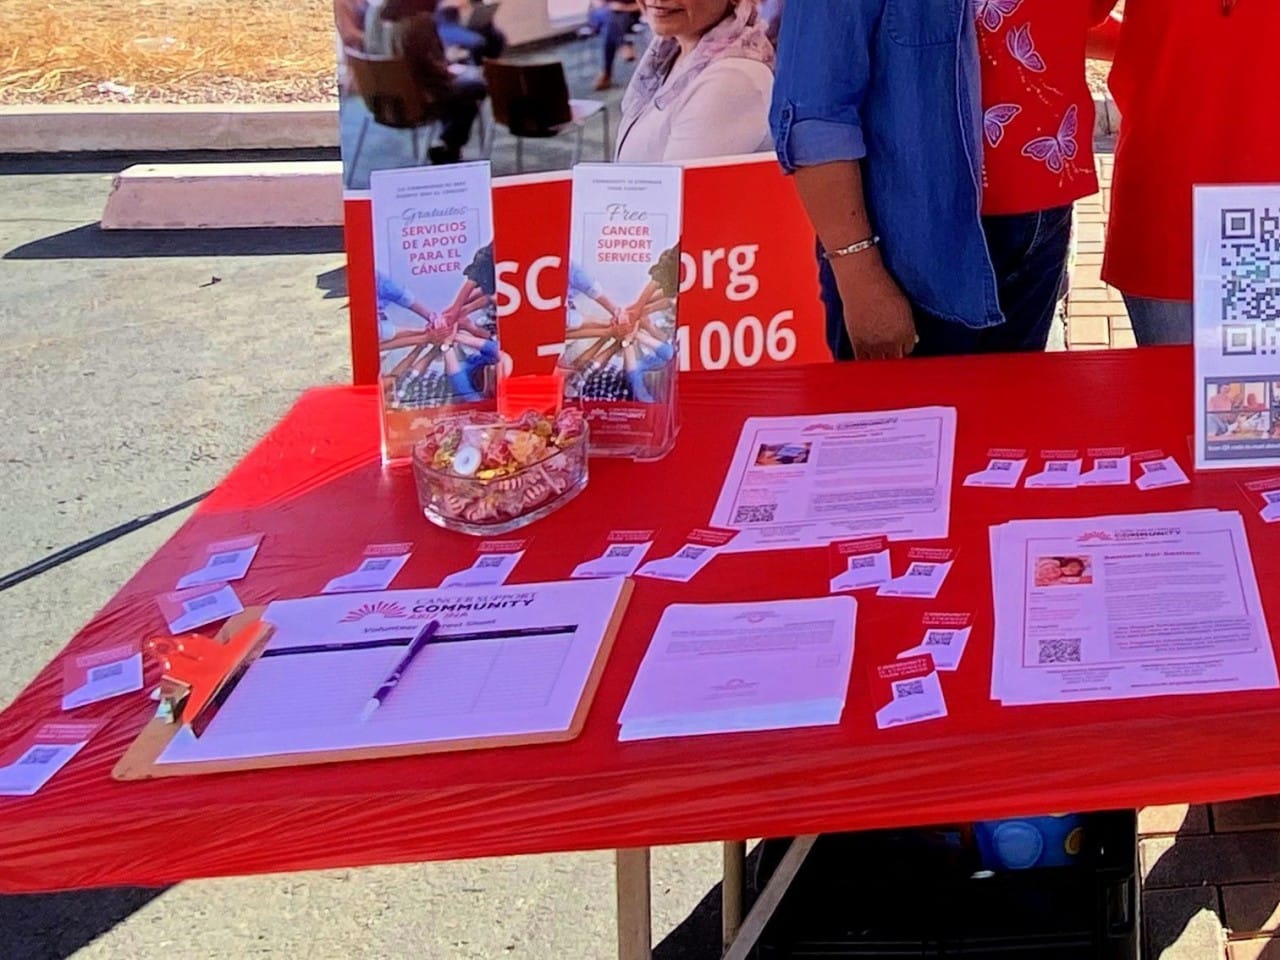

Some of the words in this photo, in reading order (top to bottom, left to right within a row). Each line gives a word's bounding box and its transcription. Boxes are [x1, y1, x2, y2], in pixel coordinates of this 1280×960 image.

[402, 206, 468, 226] Gratuitos
[606, 203, 648, 221] Free
[401, 221, 467, 238] SERVICIOS
[601, 226, 650, 236] CANCER
[402, 239, 419, 251] DE
[422, 234, 468, 248] APOYO
[597, 239, 653, 249] SUPPORT
[409, 251, 444, 262] PARA
[448, 248, 462, 258] EL
[597, 253, 652, 263] SERVICES
[411, 261, 461, 276] CÁNCER
[1113, 529, 1181, 538] COMMUNITY
[415, 594, 475, 606] CANCER
[477, 591, 539, 603] SUPPORT
[412, 599, 535, 614] COMMUNITY
[364, 623, 418, 634] Volunteer
